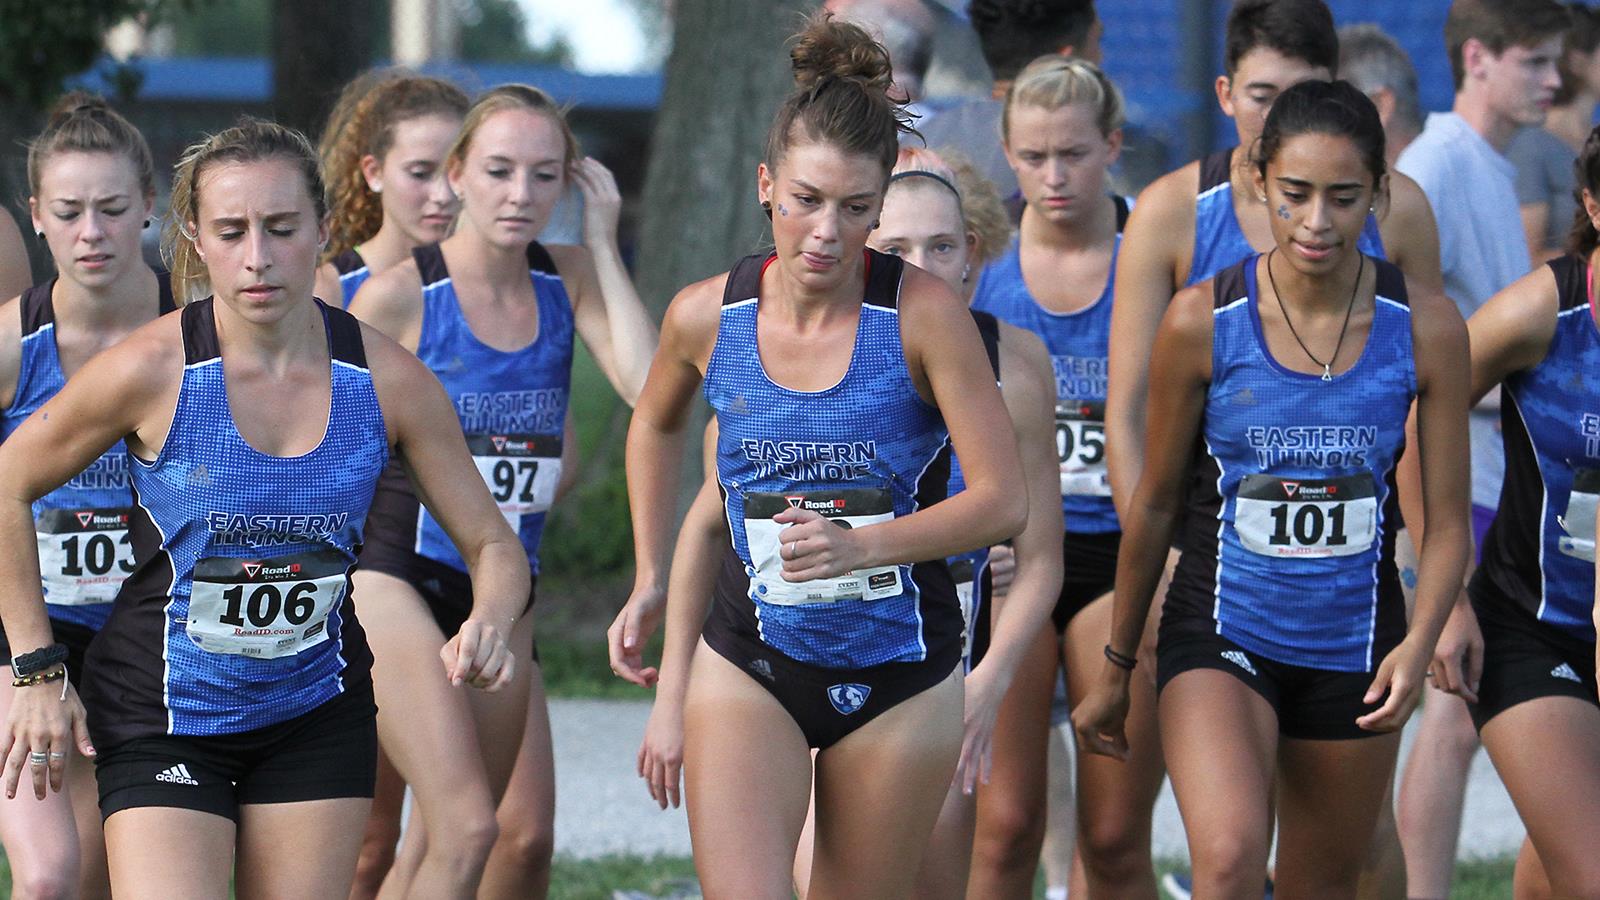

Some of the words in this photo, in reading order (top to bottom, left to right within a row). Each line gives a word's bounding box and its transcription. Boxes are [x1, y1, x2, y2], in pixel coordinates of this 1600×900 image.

[457, 388, 562, 414] EASTERN
[1056, 423, 1104, 464] 05
[1245, 426, 1377, 449] EASTERN
[741, 439, 877, 464] EASTERN
[1257, 448, 1369, 470] ILLINOIS
[492, 460, 539, 502] 97
[754, 461, 871, 480] ILLINOIS
[205, 511, 348, 534] EASTERN
[1269, 503, 1347, 545] 101
[219, 582, 318, 628] 106
[233, 628, 295, 637] RoadID.com
[155, 773, 199, 786] adidas
